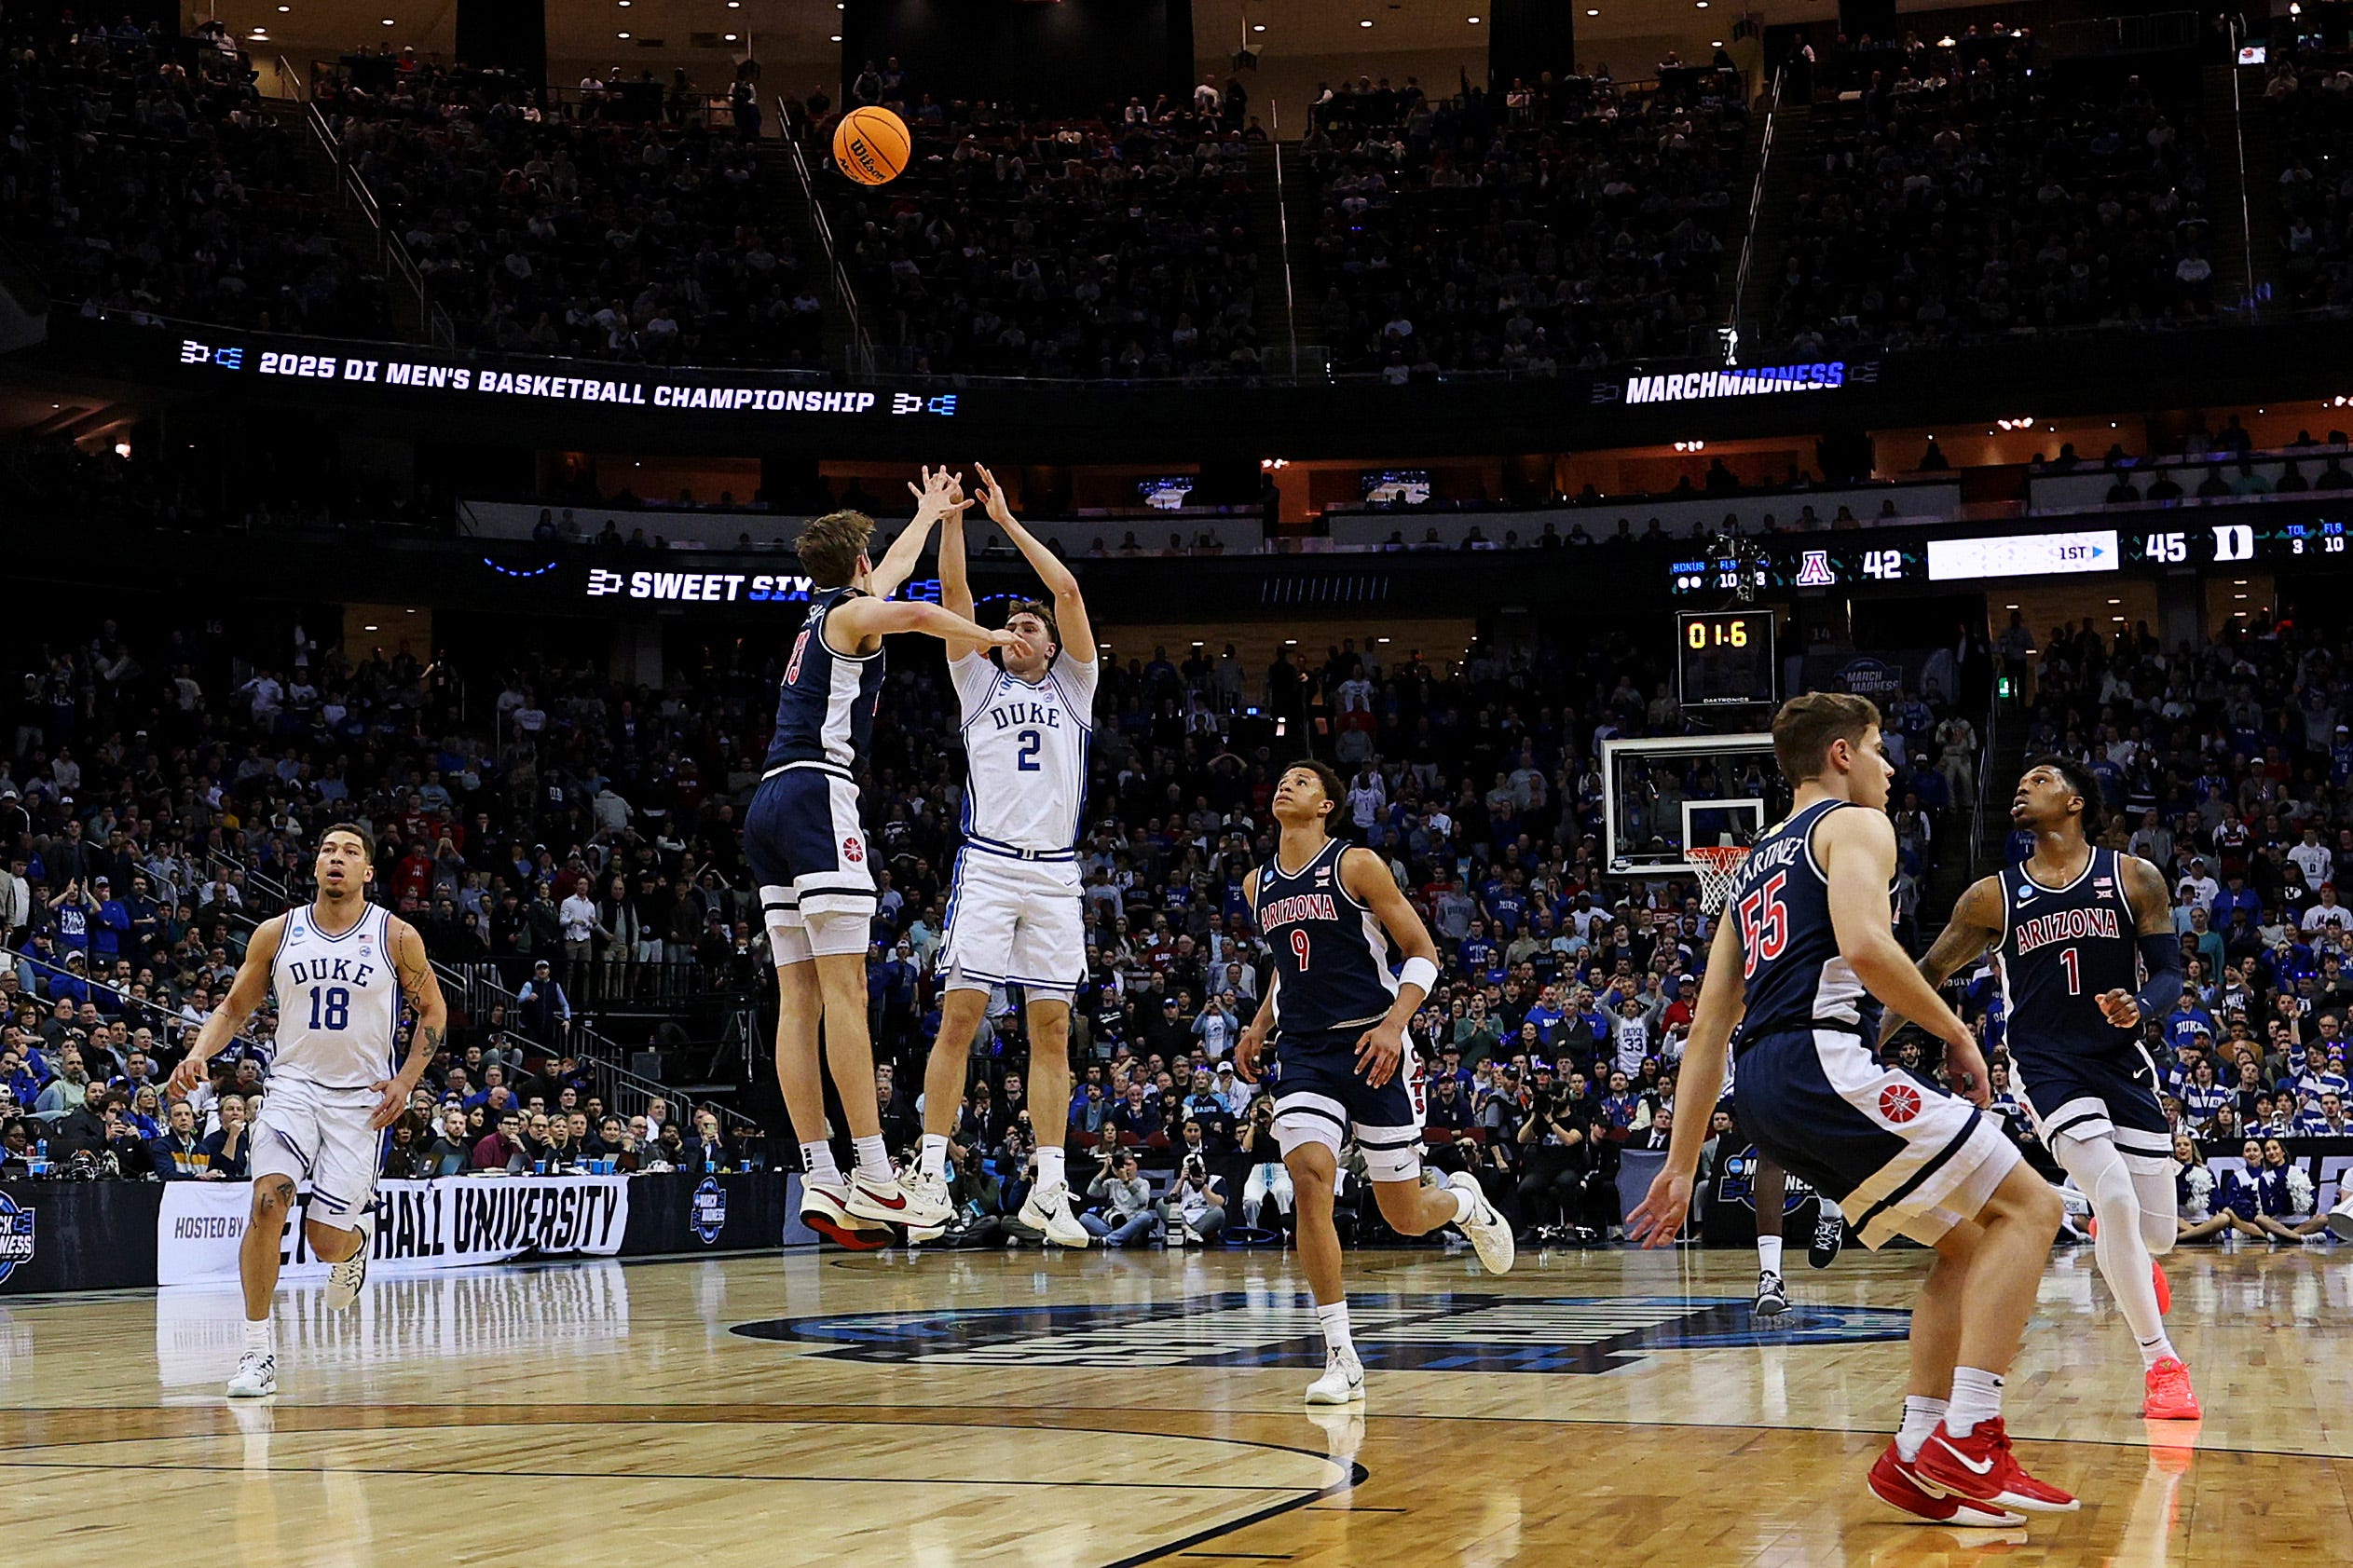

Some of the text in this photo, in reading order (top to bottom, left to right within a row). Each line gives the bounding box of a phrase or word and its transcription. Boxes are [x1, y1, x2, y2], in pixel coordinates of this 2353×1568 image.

[851, 138, 886, 181] Wilson
[259, 352, 875, 413] 2025 DI MEN'S BASKETBALL CHAMPIONSHIP
[2059, 545, 2086, 560] 1ST
[2145, 532, 2187, 563] 45
[2291, 539, 2304, 554] 3
[2324, 537, 2344, 552] 10
[1673, 561, 1705, 573] BONUS
[1864, 550, 1902, 579] 42
[630, 571, 813, 604] SWEET SIX
[1719, 573, 1737, 588] 10
[1846, 670, 1882, 683] MARCH
[991, 702, 1060, 730] DUKE
[1018, 729, 1041, 771] 2
[1729, 837, 1805, 912] MARTINEZ
[1260, 893, 1339, 935] ARIZONA
[1498, 899, 1519, 912] DUKE
[1738, 868, 1788, 980] 55
[2016, 907, 2121, 957] ARIZONA
[1290, 928, 1310, 973] 9
[289, 958, 374, 988] DUKE
[2059, 947, 2081, 996] 1
[308, 986, 349, 1030] 18
[1623, 1038, 1644, 1052] 33
[174, 1216, 244, 1239] HOSTED BY
[373, 1188, 445, 1261] HALL
[454, 1184, 619, 1252] UNIVERSITY
